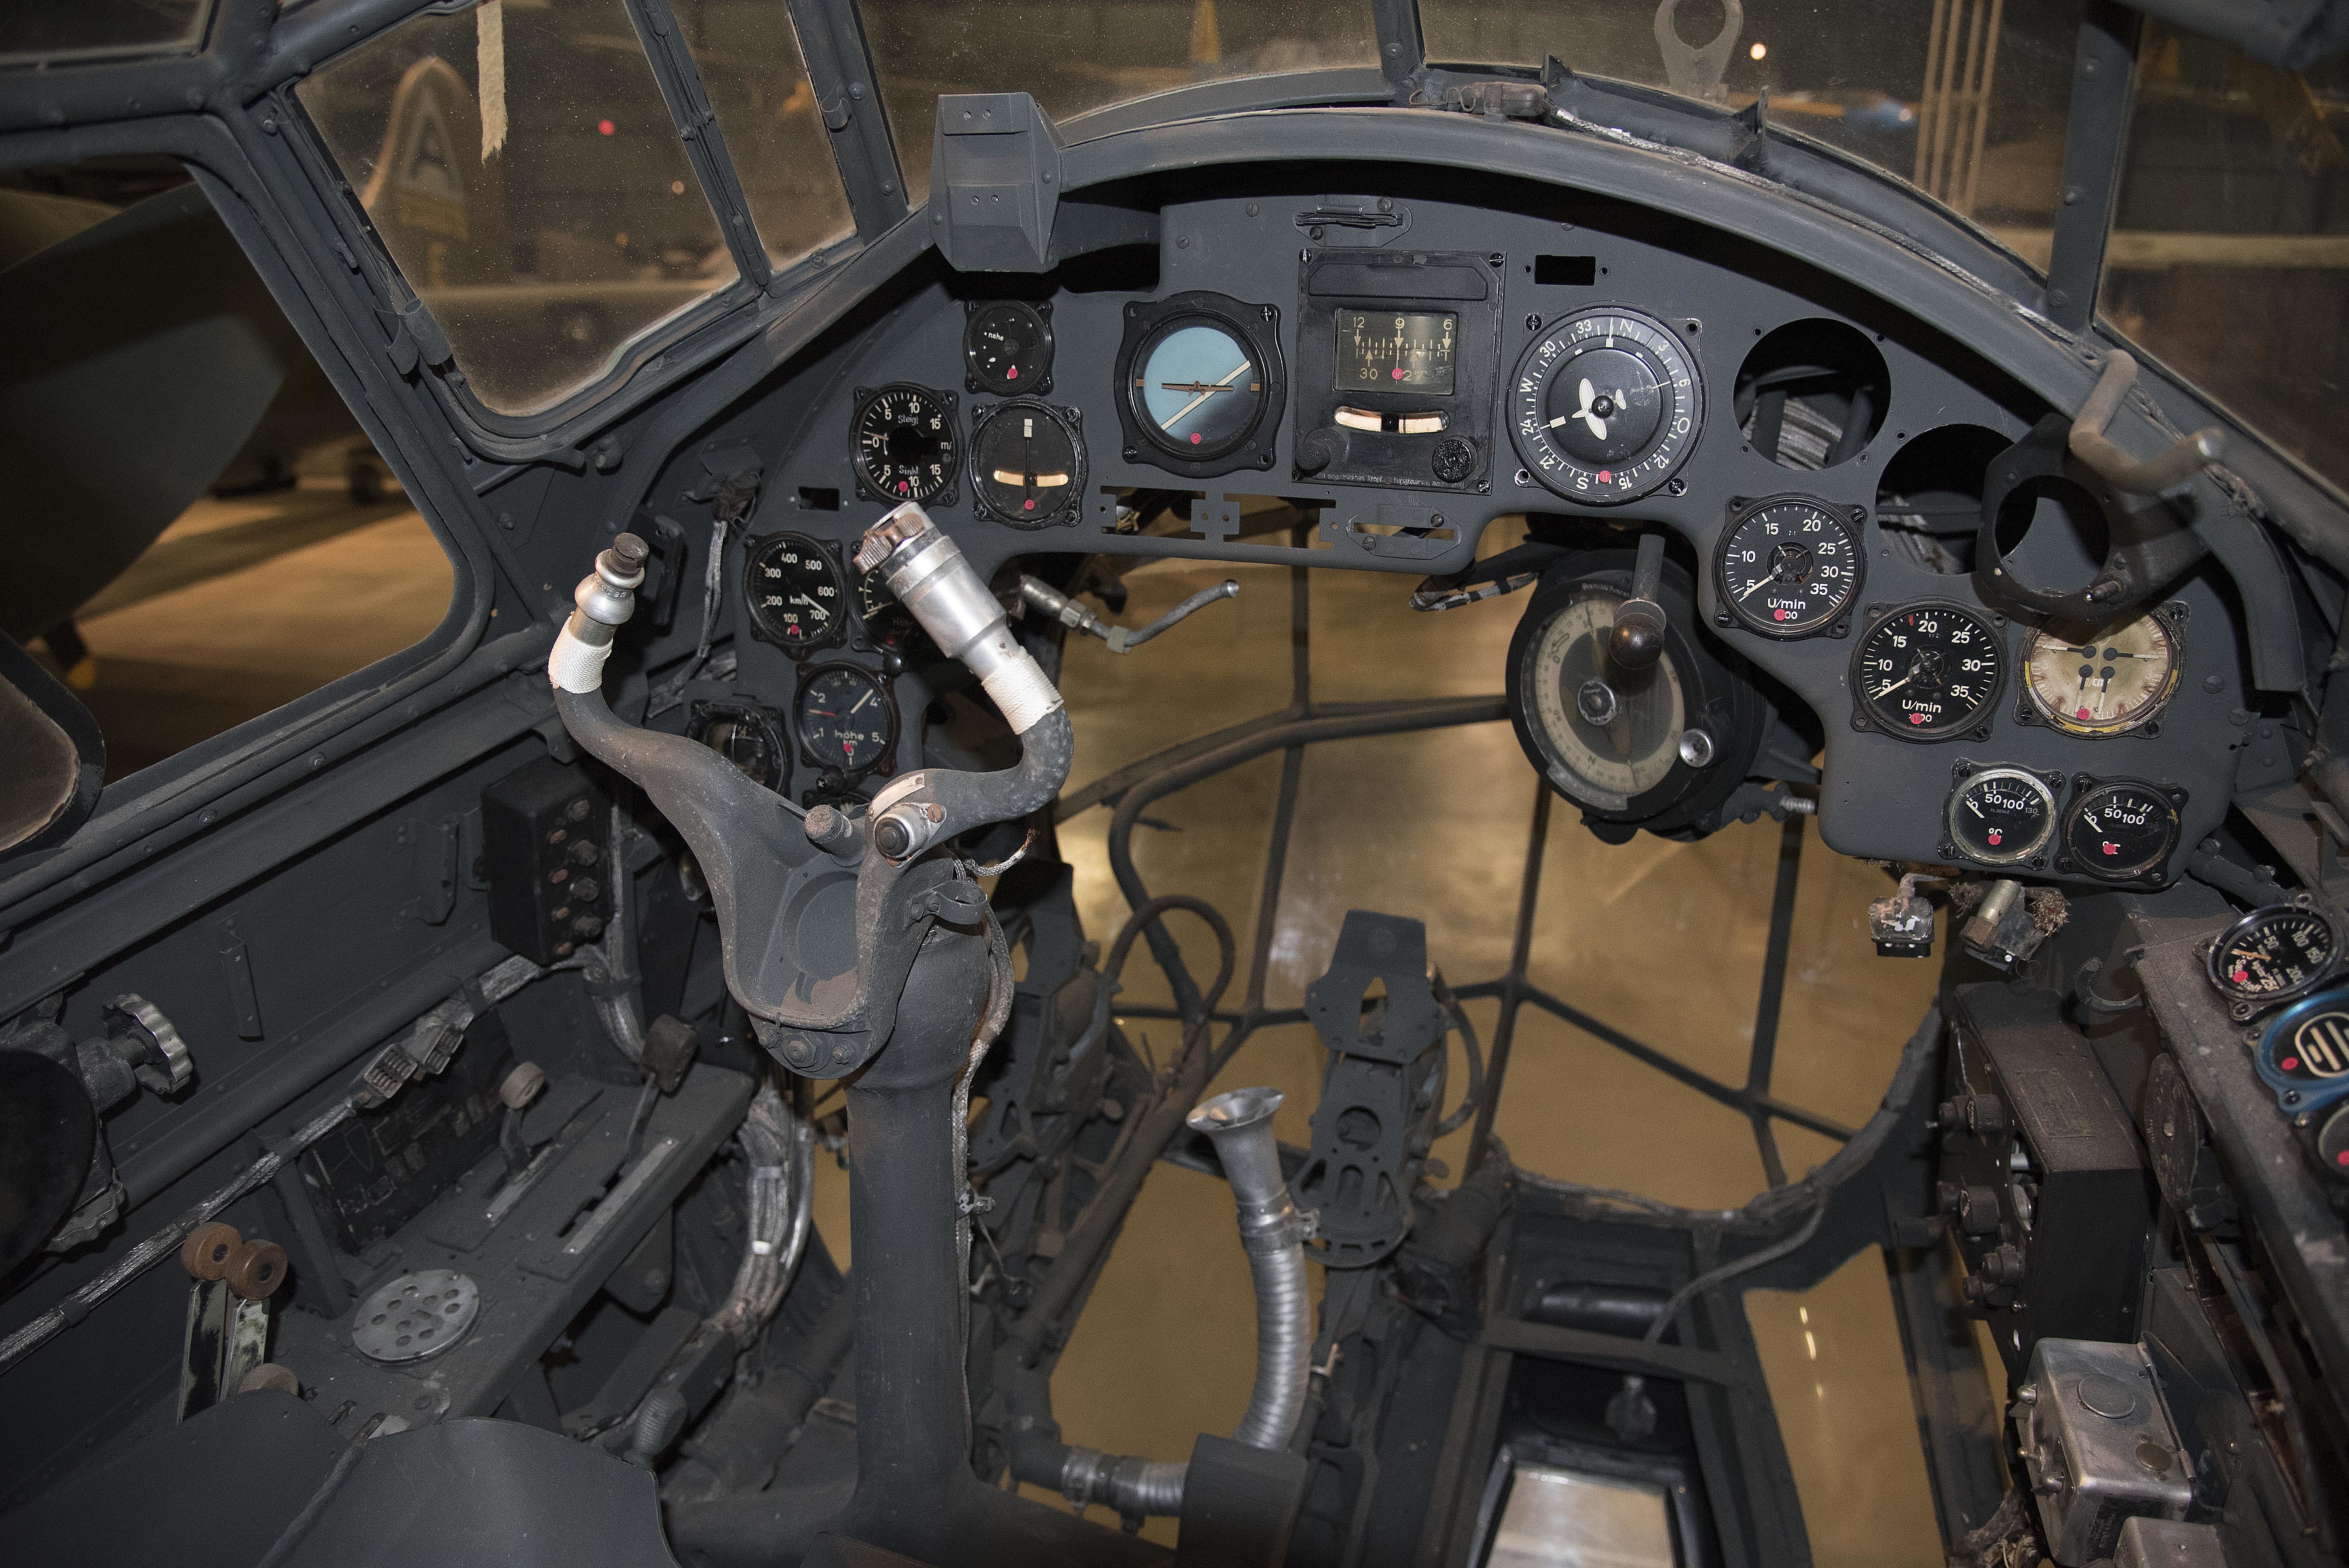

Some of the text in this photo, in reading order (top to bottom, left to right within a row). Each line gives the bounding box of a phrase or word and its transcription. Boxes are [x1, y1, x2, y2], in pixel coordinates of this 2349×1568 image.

[1353, 317, 1365, 328] 12
[1395, 318, 1405, 329] 9
[1443, 319, 1453, 330] 6
[1576, 319, 1592, 334] 33
[1620, 318, 1634, 333] N
[988, 333, 1004, 342] nahe
[1539, 341, 1556, 358] 30
[1658, 340, 1670, 352] 3
[1360, 368, 1378, 380] 30
[1519, 378, 1534, 393] W
[909, 402, 920, 414] 10
[885, 409, 892, 421] 5
[930, 418, 941, 430] 15
[1522, 418, 1535, 435] 24
[872, 437, 879, 448] 0
[1539, 456, 1556, 470] 21
[1654, 454, 1670, 469] 12
[884, 465, 891, 476] 5
[930, 464, 941, 476] 15
[909, 476, 920, 487] 10
[1576, 477, 1588, 490] S
[1618, 476, 1633, 490] 15
[1765, 523, 1779, 535] 15
[1802, 519, 1821, 532] 20
[1818, 542, 1836, 555] 25
[781, 552, 797, 563] 400
[1741, 551, 1756, 563] 10
[805, 559, 822, 570] 500
[765, 567, 781, 578] 300
[1821, 566, 1839, 578] 30
[1746, 579, 1756, 590] 5
[1810, 583, 1828, 595] 35
[818, 586, 834, 597] 600
[766, 595, 782, 606] 200
[1767, 598, 1806, 610] U/min
[783, 613, 798, 624] 100
[809, 609, 826, 620] 700
[1918, 620, 1937, 633] 20
[1893, 636, 1907, 648] 15
[1951, 631, 1970, 644] 25
[1878, 659, 1893, 671] 10
[1962, 659, 1981, 672] 30
[1882, 679, 1892, 691] 5
[1950, 685, 1969, 698] 35
[818, 693, 826, 703] 2
[870, 697, 878, 707] 4
[1902, 699, 1942, 713] U/min
[820, 727, 824, 738] 1
[872, 731, 879, 742] 5
[1985, 793, 2002, 804] 50
[2003, 798, 2024, 810] 100
[2104, 808, 2122, 818] 50
[2122, 814, 2145, 825] 100
[2263, 935, 2279, 950] 50
[2291, 930, 2310, 948] 100
[2305, 946, 2323, 964] 150
